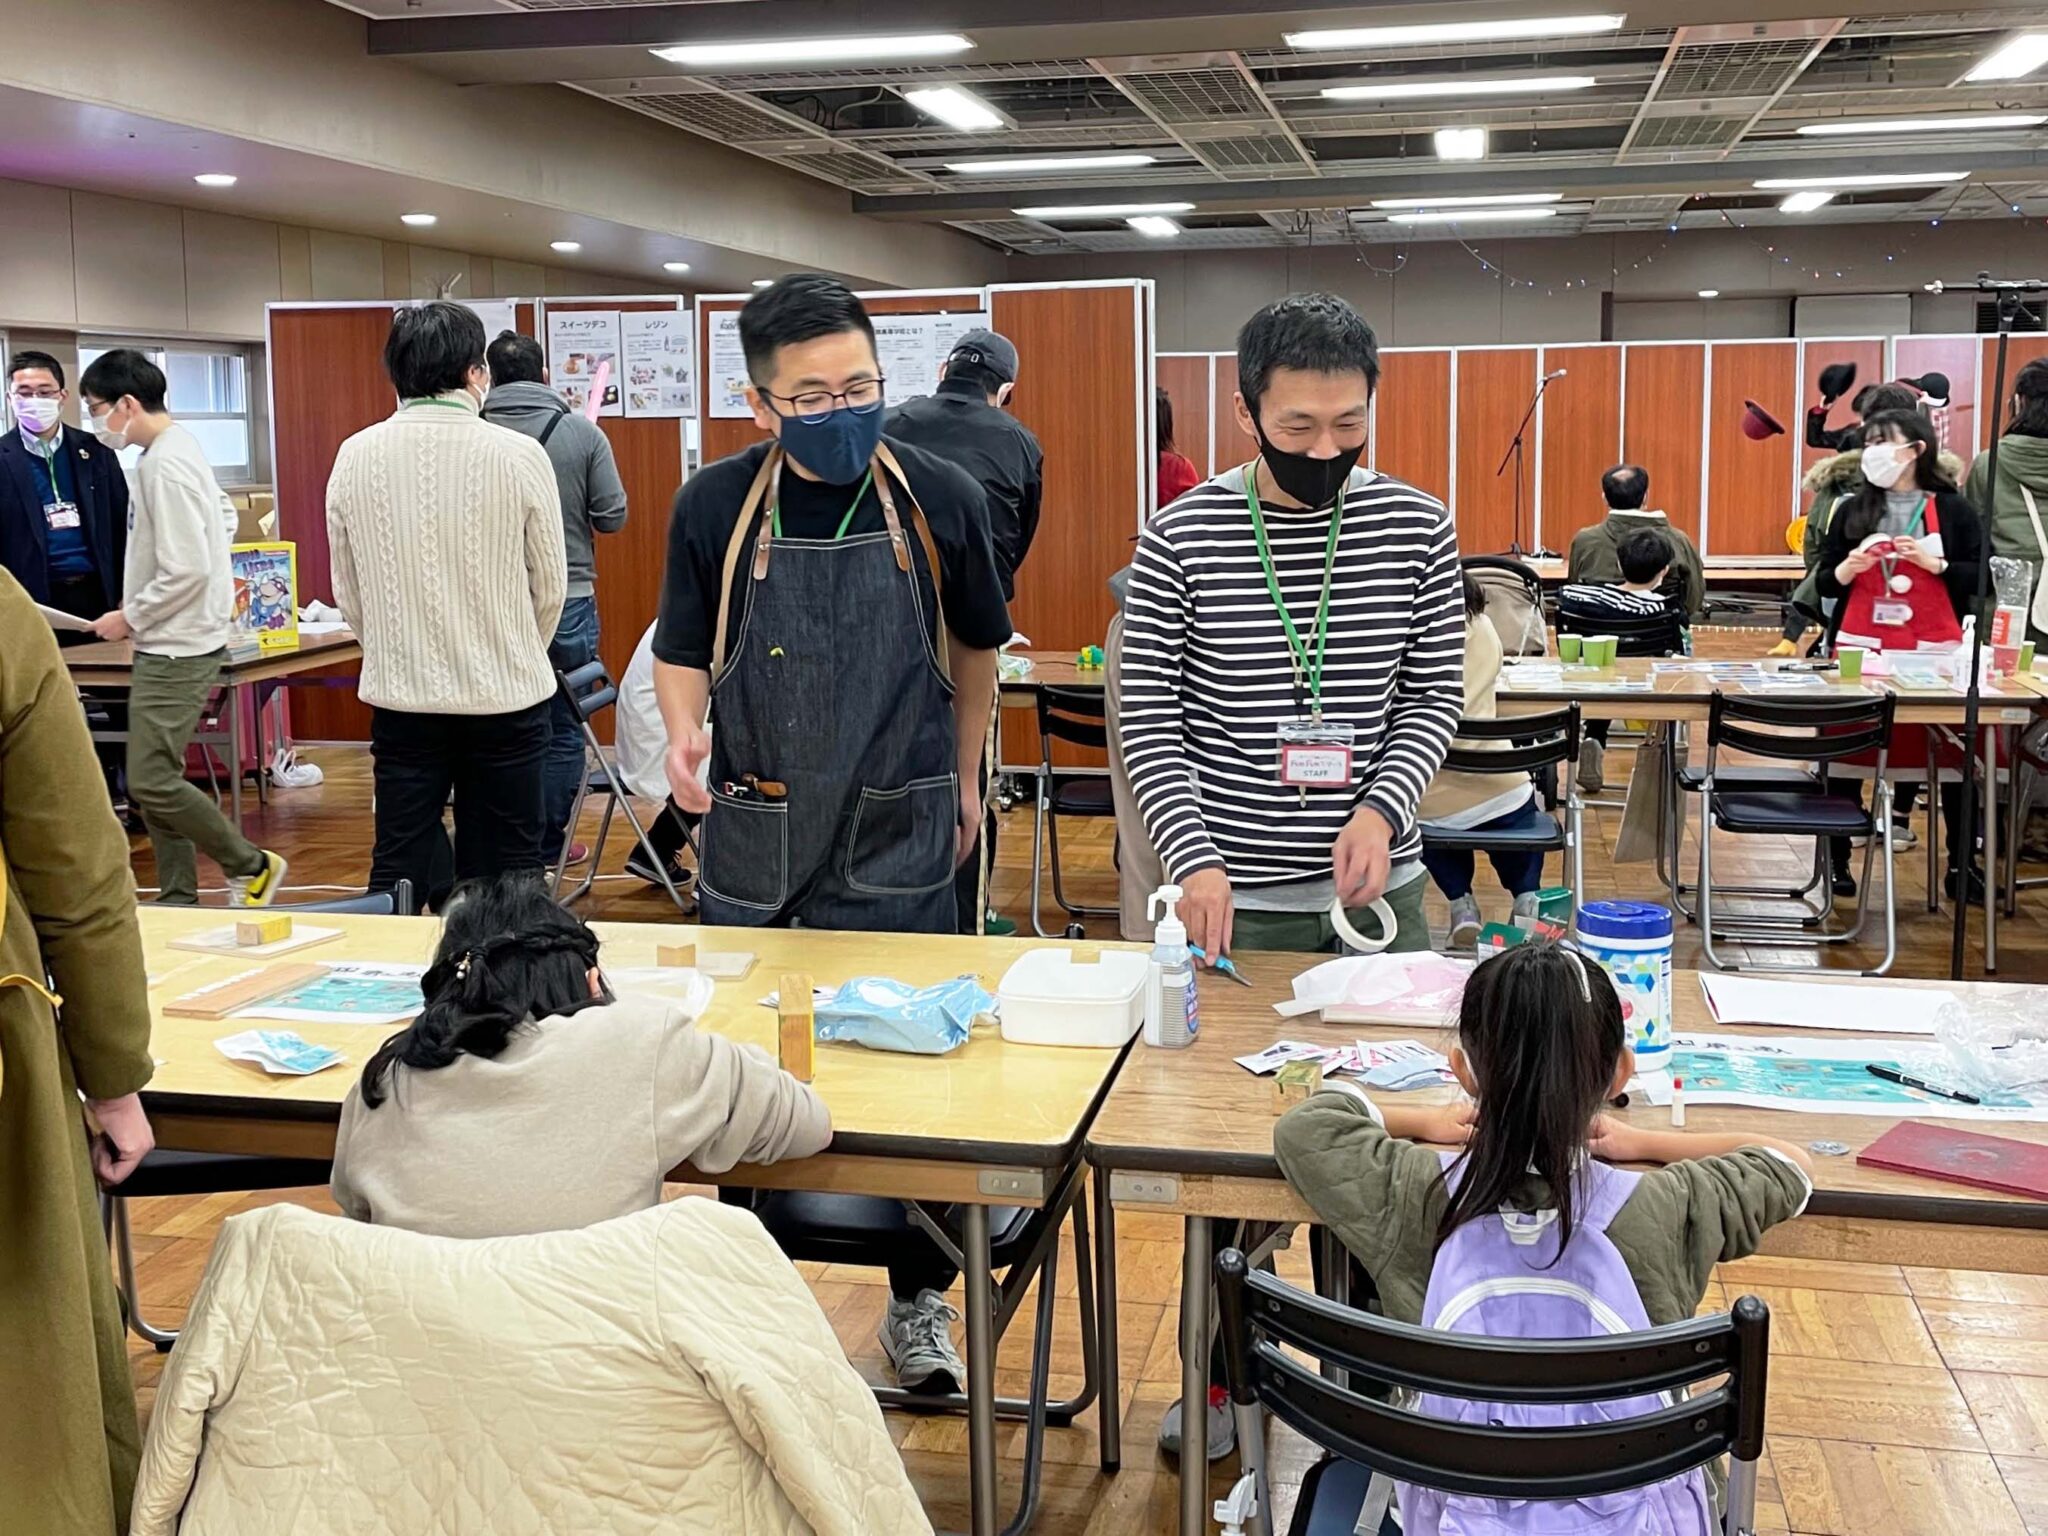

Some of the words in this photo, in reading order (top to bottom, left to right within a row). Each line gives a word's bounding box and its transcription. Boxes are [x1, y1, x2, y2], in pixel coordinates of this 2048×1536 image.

[560, 320, 607, 329] スイーツデコ
[645, 320, 669, 329] レジン
